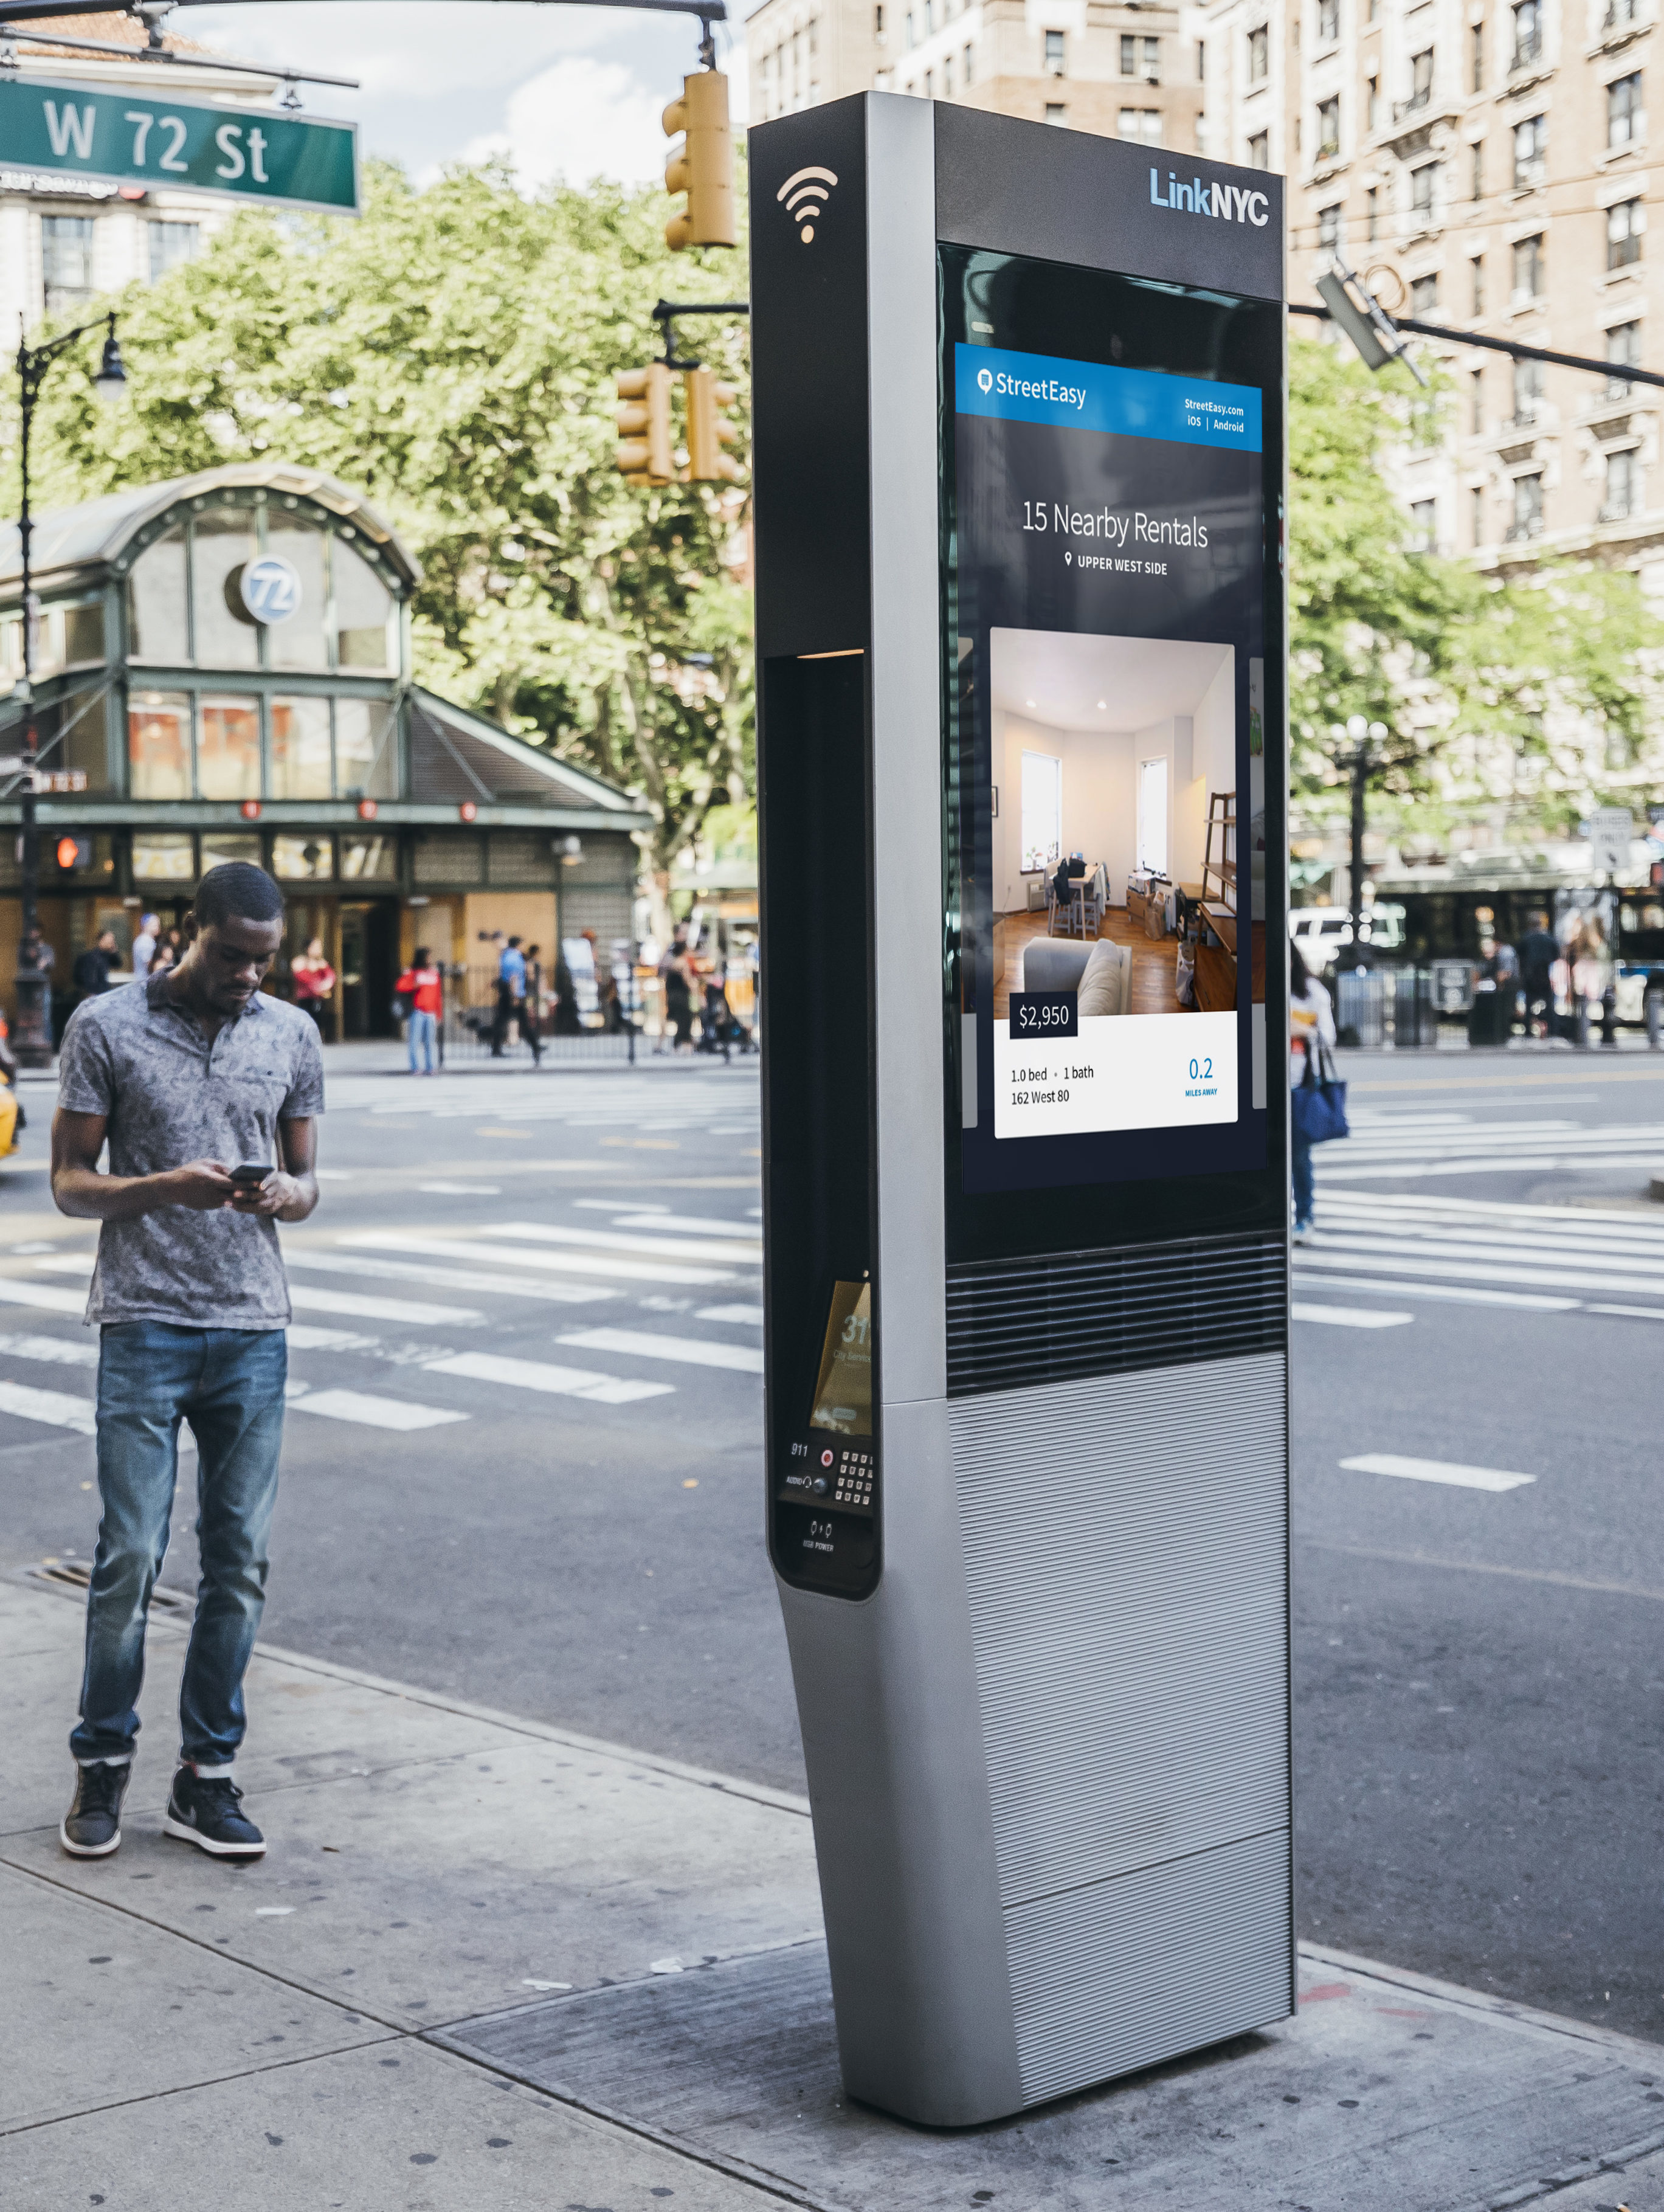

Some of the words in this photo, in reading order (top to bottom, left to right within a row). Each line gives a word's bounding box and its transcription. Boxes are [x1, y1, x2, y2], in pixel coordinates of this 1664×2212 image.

[43, 100, 96, 159] W
[124, 110, 188, 172] 72
[215, 123, 269, 182] St
[1150, 168, 1269, 227] LinkNYC
[996, 373, 1086, 410] StreetEasy
[1185, 398, 1244, 417] StreetEasy.com
[1187, 415, 1201, 427] iOS
[1213, 419, 1244, 433] Android
[1023, 501, 1048, 531] 15
[1054, 503, 1129, 547] Nearby
[1135, 512, 1208, 548] Rentals
[1078, 555, 1113, 570] UPPER
[1114, 559, 1142, 573] WEST
[1145, 562, 1167, 575] SIDE
[252, 568, 294, 610] 72
[1020, 1004, 1069, 1029] $2,950
[1011, 1069, 1026, 1082] 1.0
[1029, 1067, 1048, 1082] bed
[1064, 1067, 1069, 1080] 1
[1072, 1065, 1094, 1079] bath
[1189, 1057, 1213, 1080] 0.2
[1011, 1091, 1029, 1105] 162
[1032, 1091, 1055, 1104] West
[1057, 1090, 1069, 1102] 80
[1185, 1089, 1201, 1097] MILES
[1202, 1088, 1218, 1097] AWAY
[842, 1315, 870, 1344] 31
[792, 1443, 808, 1457] 911
[815, 1542, 834, 1552] POWER
